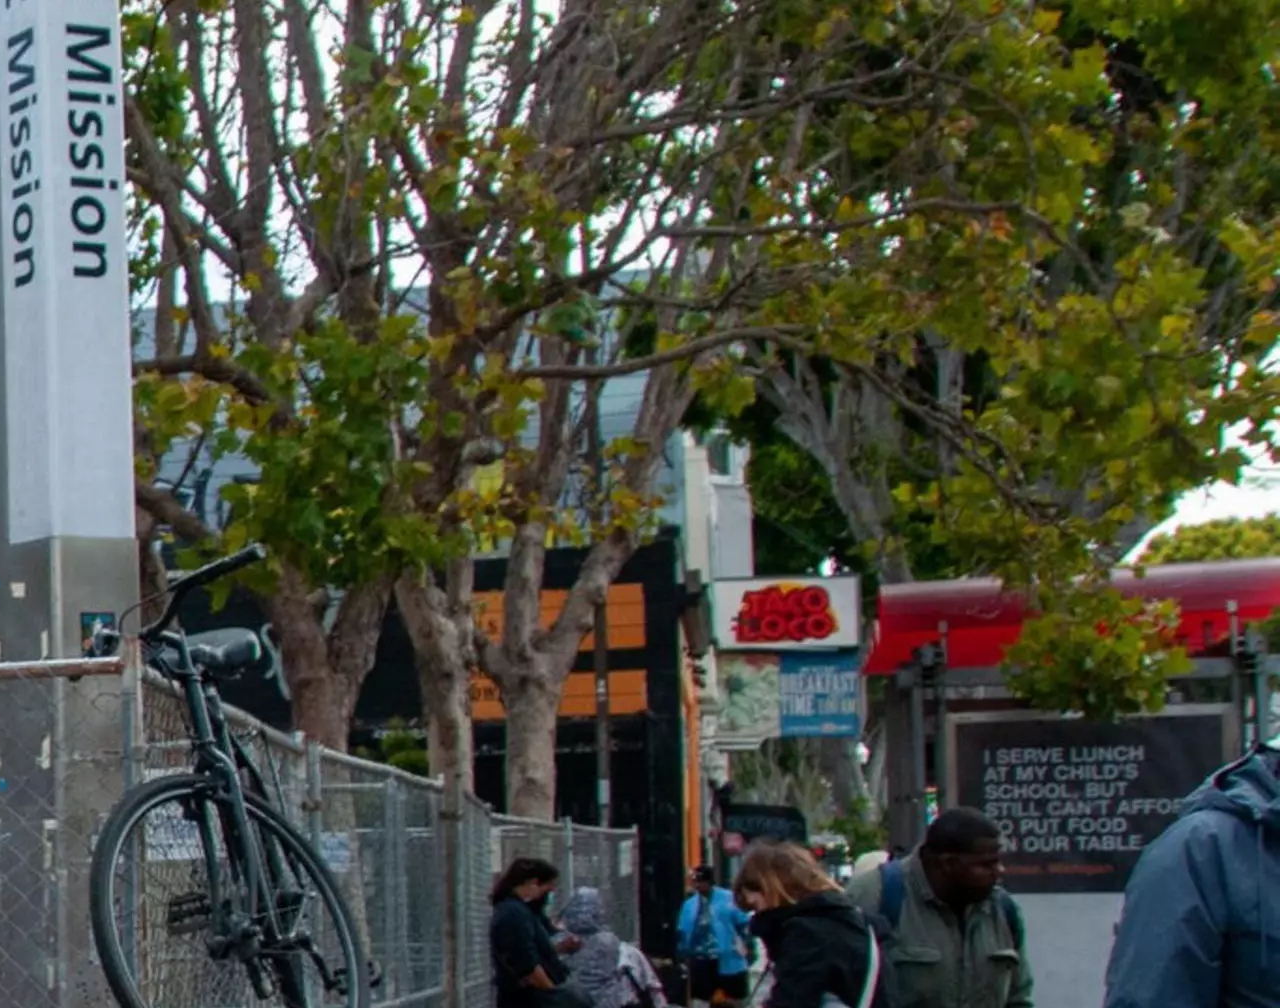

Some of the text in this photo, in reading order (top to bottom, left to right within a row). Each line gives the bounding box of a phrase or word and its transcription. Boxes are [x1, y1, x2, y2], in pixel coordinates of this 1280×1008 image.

[7, 27, 40, 288] Mission
[65, 23, 119, 279] Mission
[741, 585, 830, 614] TACO
[737, 611, 835, 642] LOCO
[984, 746, 1144, 764] I SERVE LUNCH
[984, 763, 1139, 782] AT MY CHILD'S
[1086, 782, 1129, 797] BUT
[985, 801, 1042, 818] STILL
[1047, 799, 1113, 816] CAN'T
[1020, 818, 1061, 834] PUT
[1068, 818, 1127, 833] FOOD
[1024, 836, 1070, 852] OUR
